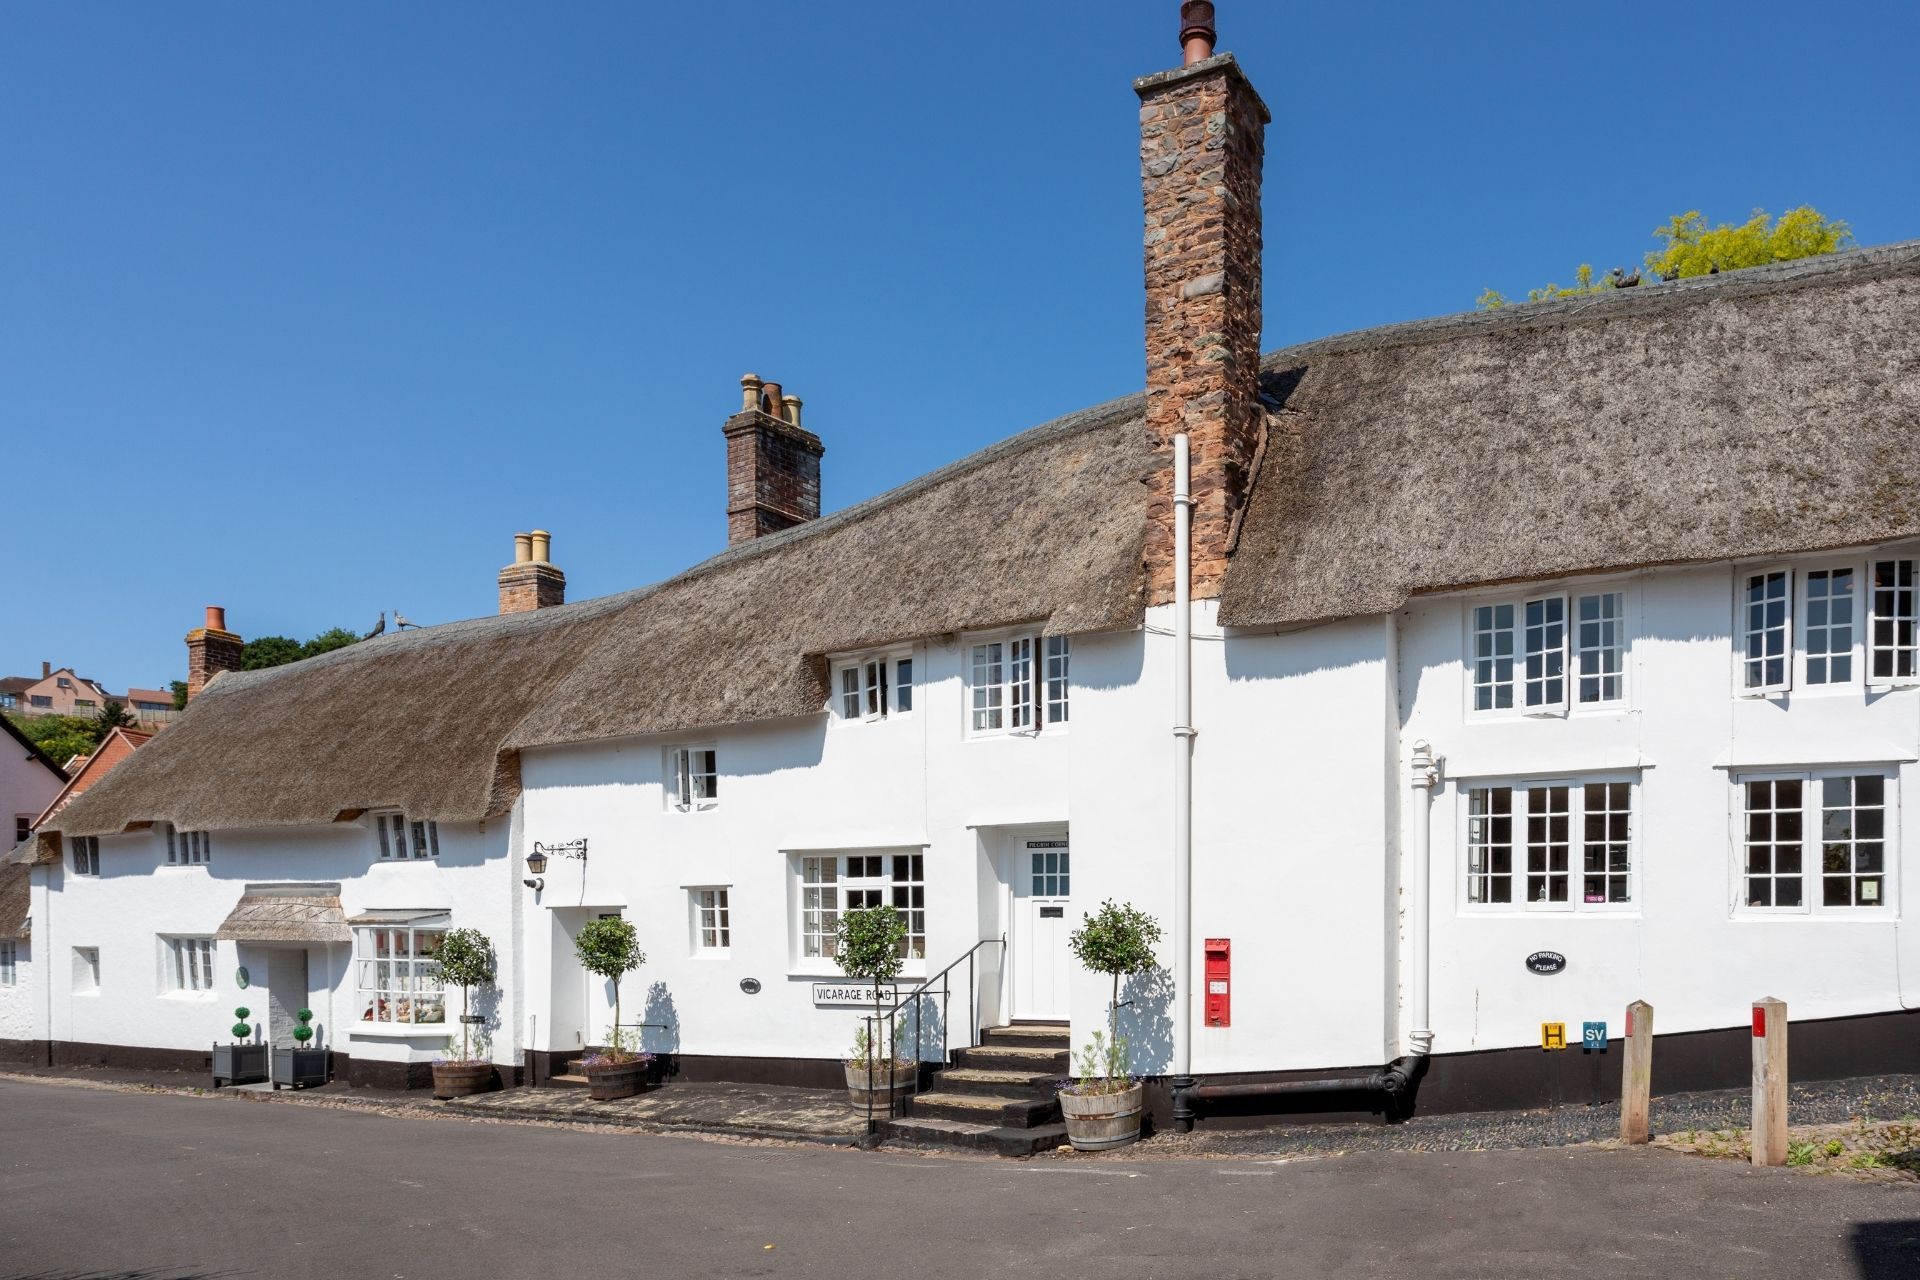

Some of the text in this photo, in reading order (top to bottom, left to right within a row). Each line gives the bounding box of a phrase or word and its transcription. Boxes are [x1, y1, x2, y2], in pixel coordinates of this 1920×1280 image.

[1529, 952, 1563, 962] NO PARKING
[1534, 963, 1557, 971] PLEASE
[817, 989, 891, 1001] VICARAGE ROAD
[1544, 1025, 1563, 1046] H
[1585, 1029, 1604, 1041] SV
